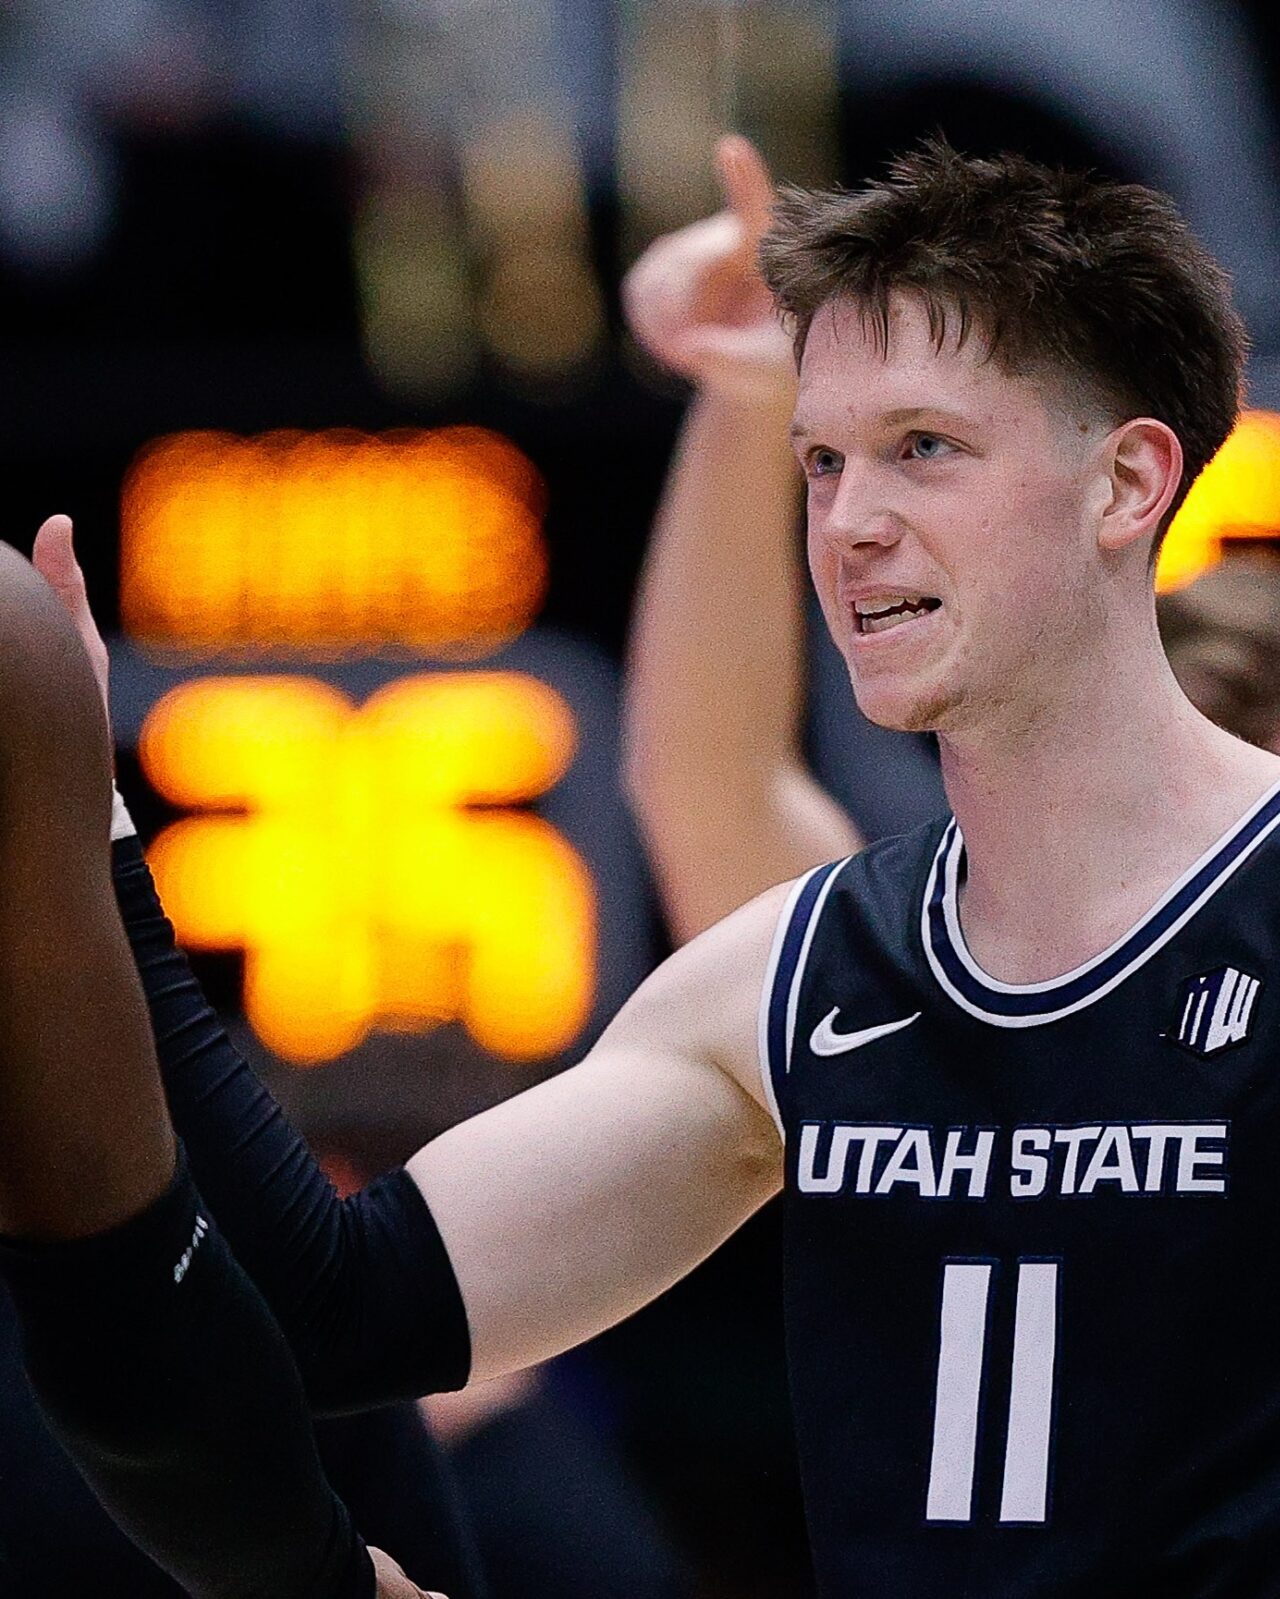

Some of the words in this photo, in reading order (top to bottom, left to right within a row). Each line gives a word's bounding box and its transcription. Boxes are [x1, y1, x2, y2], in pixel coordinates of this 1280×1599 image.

[798, 1125, 996, 1197] UTAH
[1009, 1125, 1227, 1197] STATE
[926, 1262, 1058, 1522] 11
